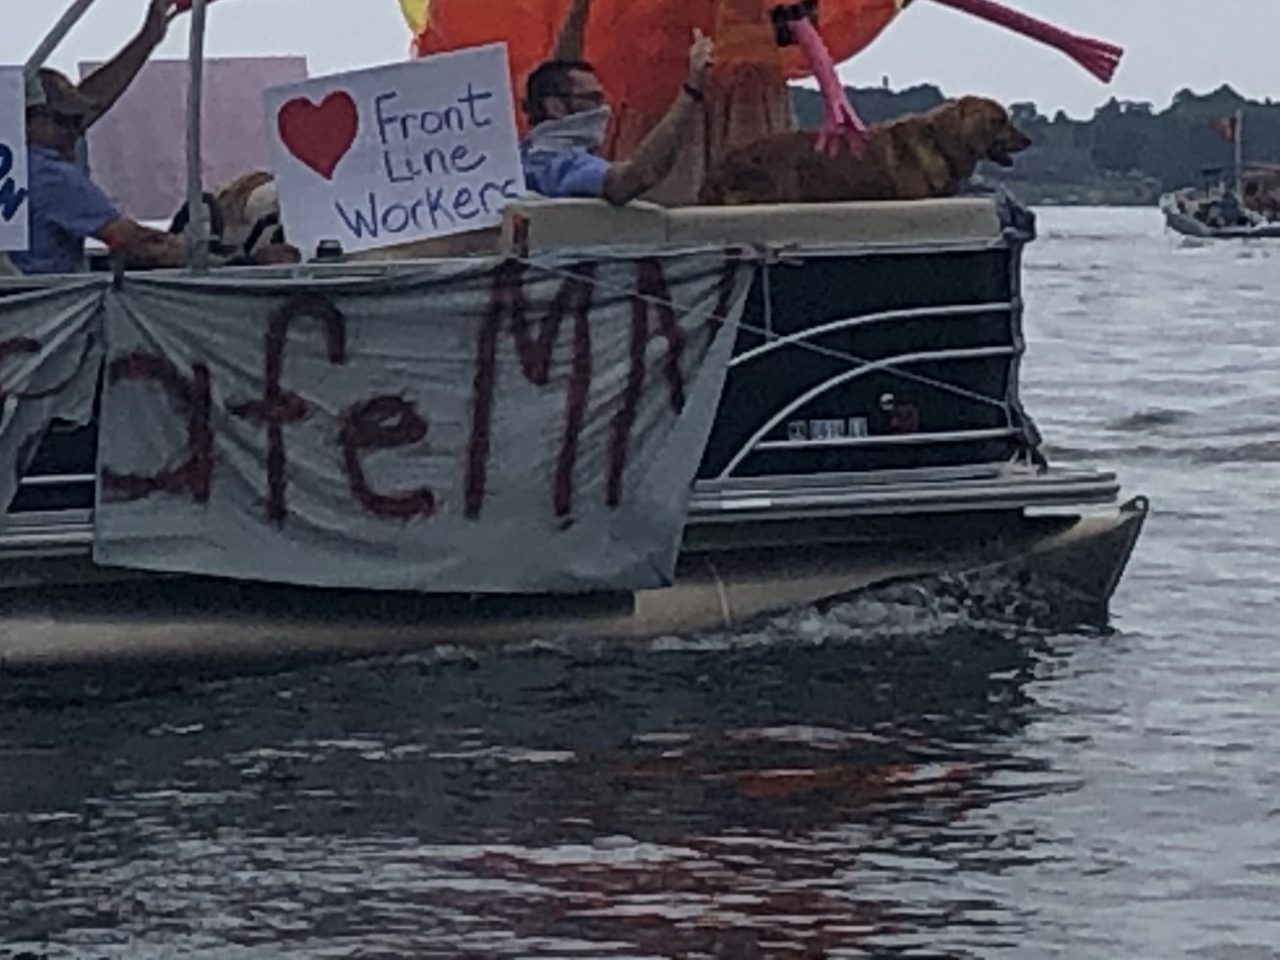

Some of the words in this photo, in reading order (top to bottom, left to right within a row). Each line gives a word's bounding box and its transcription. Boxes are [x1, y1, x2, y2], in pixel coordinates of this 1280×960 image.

[375, 83, 492, 144] Front
[384, 145, 487, 183] Line
[335, 178, 519, 239] Workers
